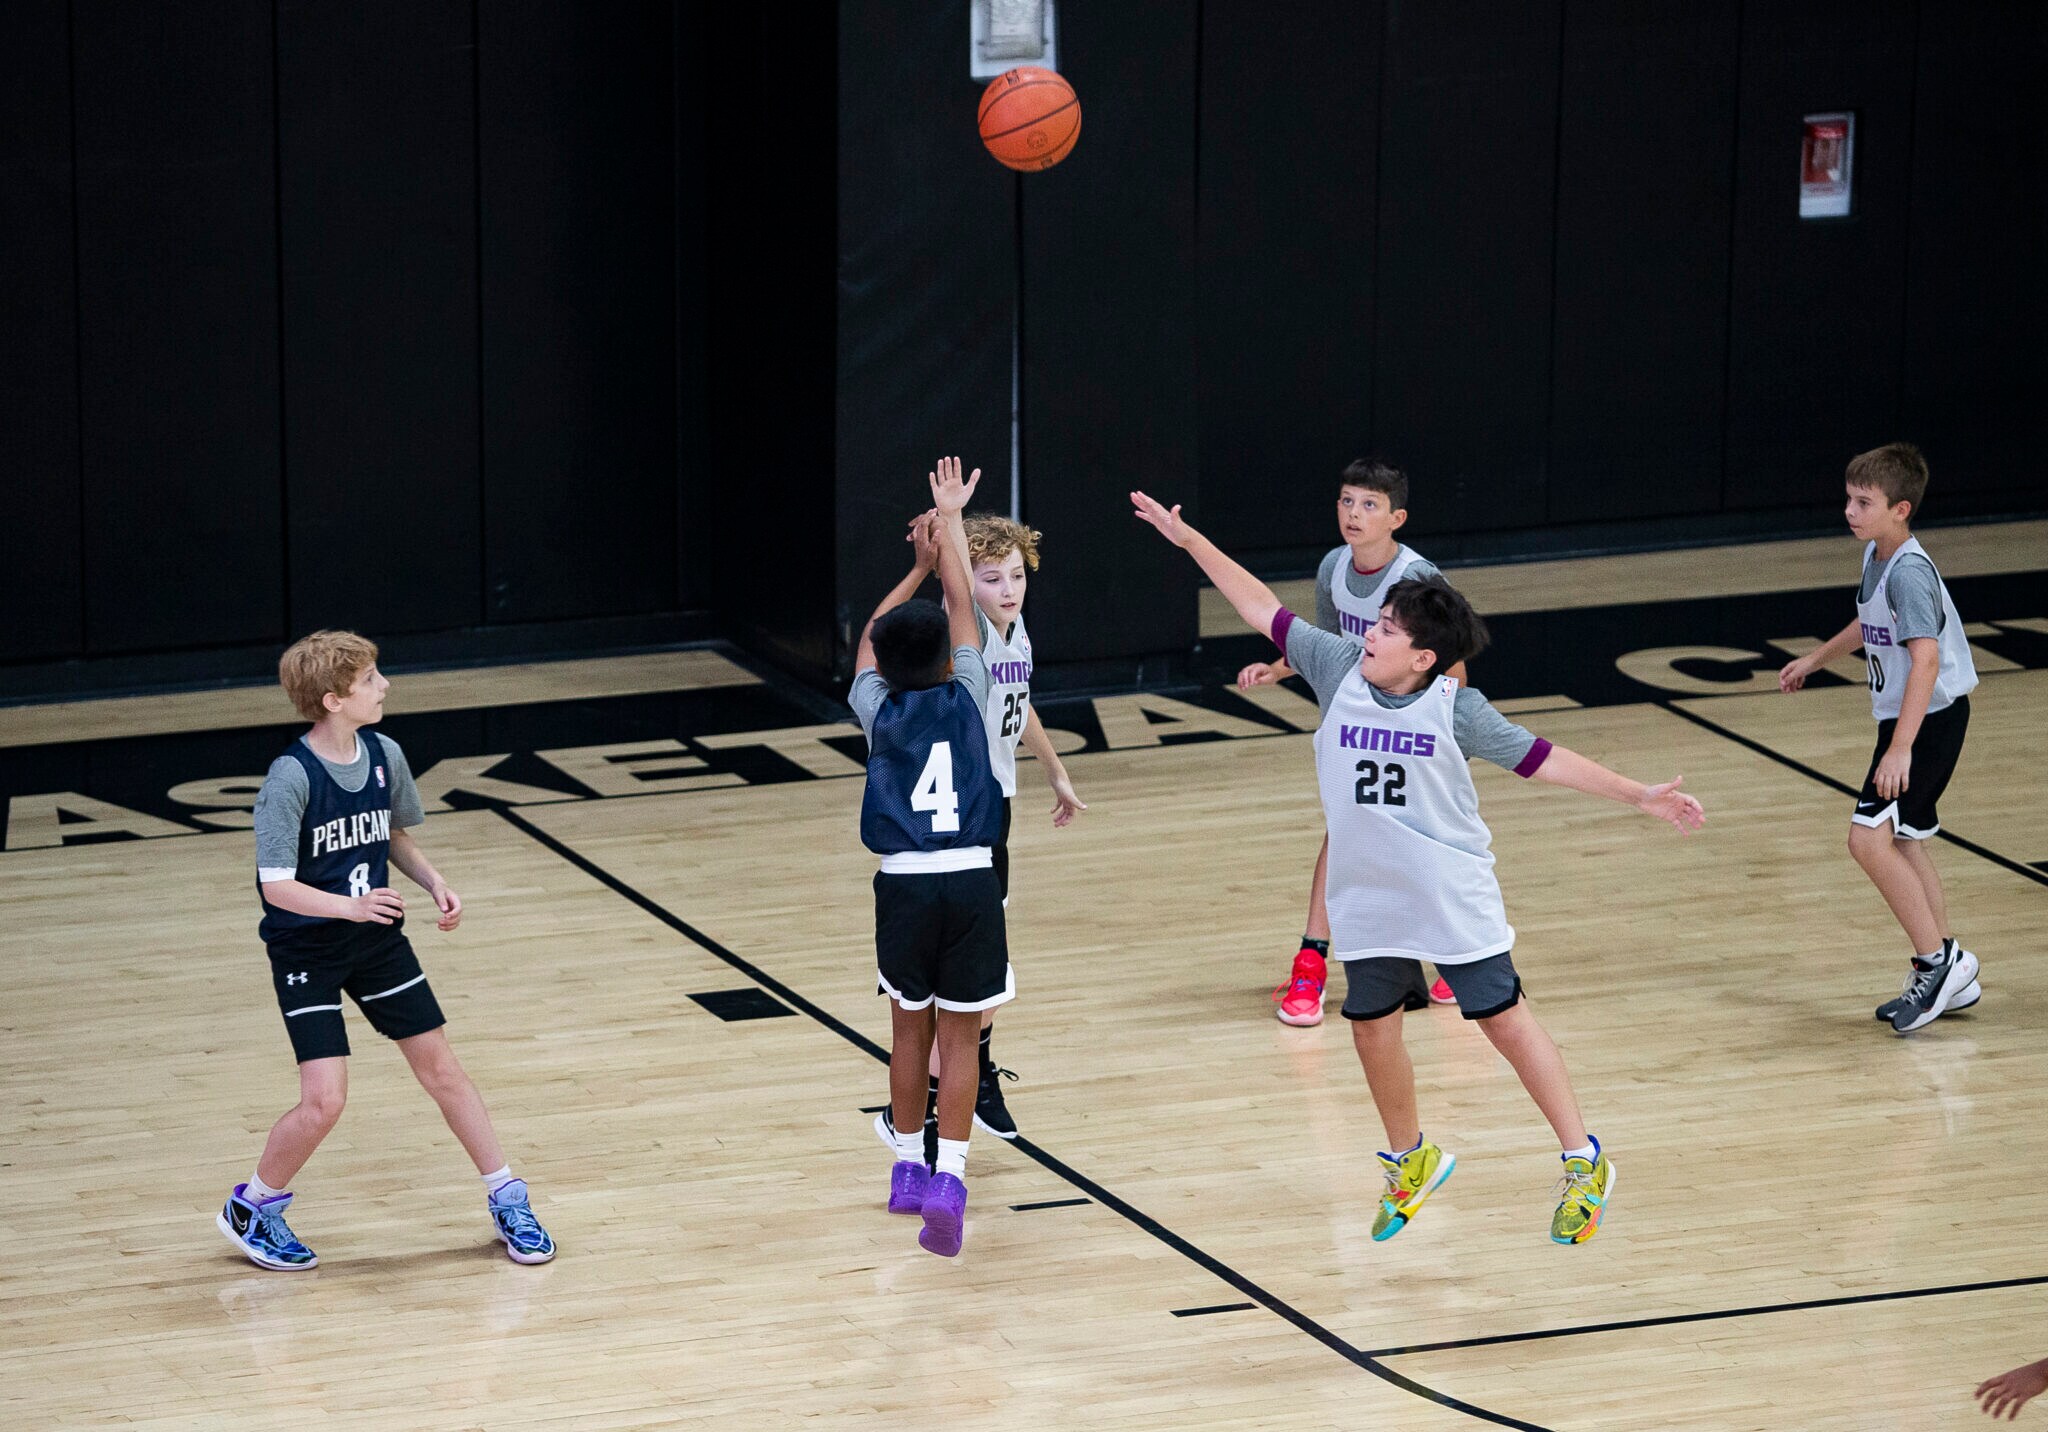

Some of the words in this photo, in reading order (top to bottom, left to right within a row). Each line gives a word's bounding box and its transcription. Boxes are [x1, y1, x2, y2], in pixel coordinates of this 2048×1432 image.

[1000, 691, 1028, 738] 25
[1340, 724, 1436, 757] KINGS
[910, 740, 960, 833] 4
[1355, 759, 1406, 807] 22
[348, 862, 371, 899] 8
